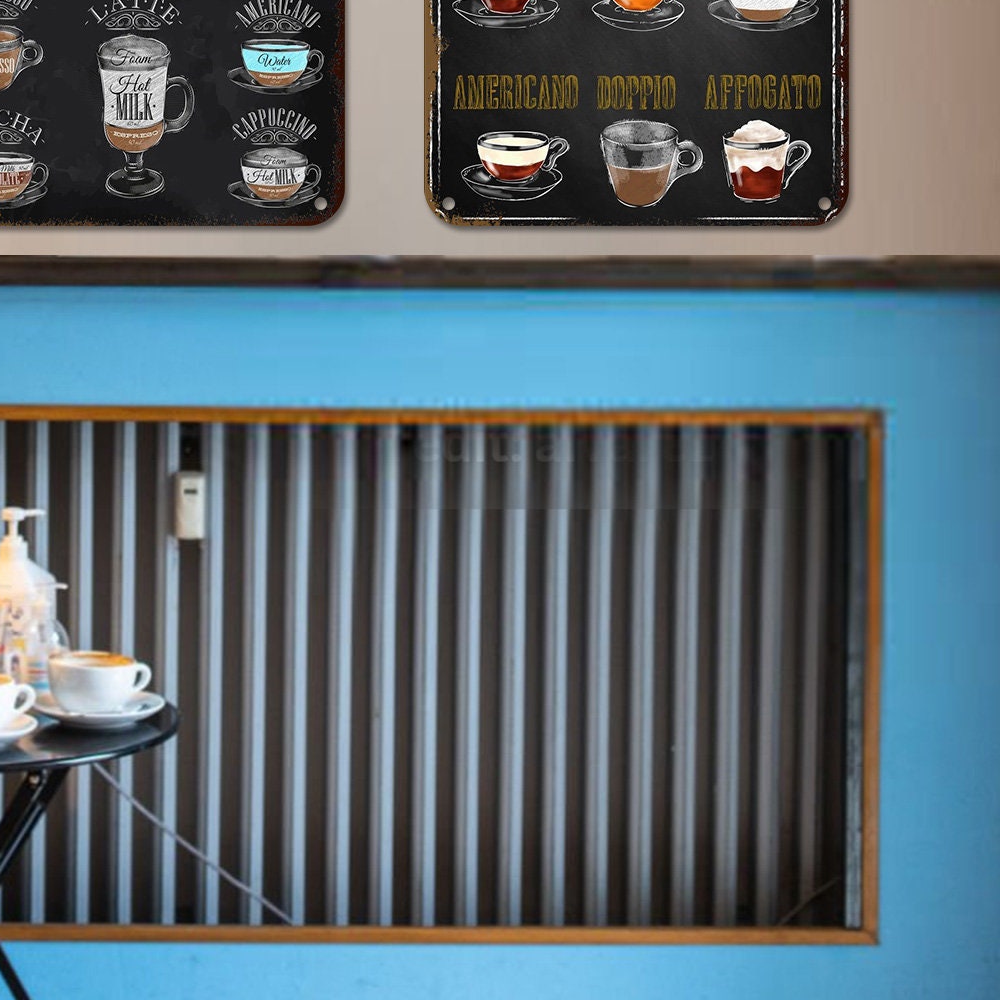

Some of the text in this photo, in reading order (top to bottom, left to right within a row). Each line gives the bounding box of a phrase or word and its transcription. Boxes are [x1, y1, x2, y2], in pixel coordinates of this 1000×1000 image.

[111, 48, 152, 66] Foam
[257, 53, 291, 67] Water
[110, 73, 152, 94] Hot
[453, 74, 579, 110] AMERICANO
[597, 75, 676, 110] DOPPIO
[703, 74, 821, 110] AFFOGATO
[116, 93, 154, 120] MILK
[232, 107, 317, 140] CAPPUCCINO
[261, 154, 287, 166] Foam
[247, 168, 297, 185] Hot MILK
